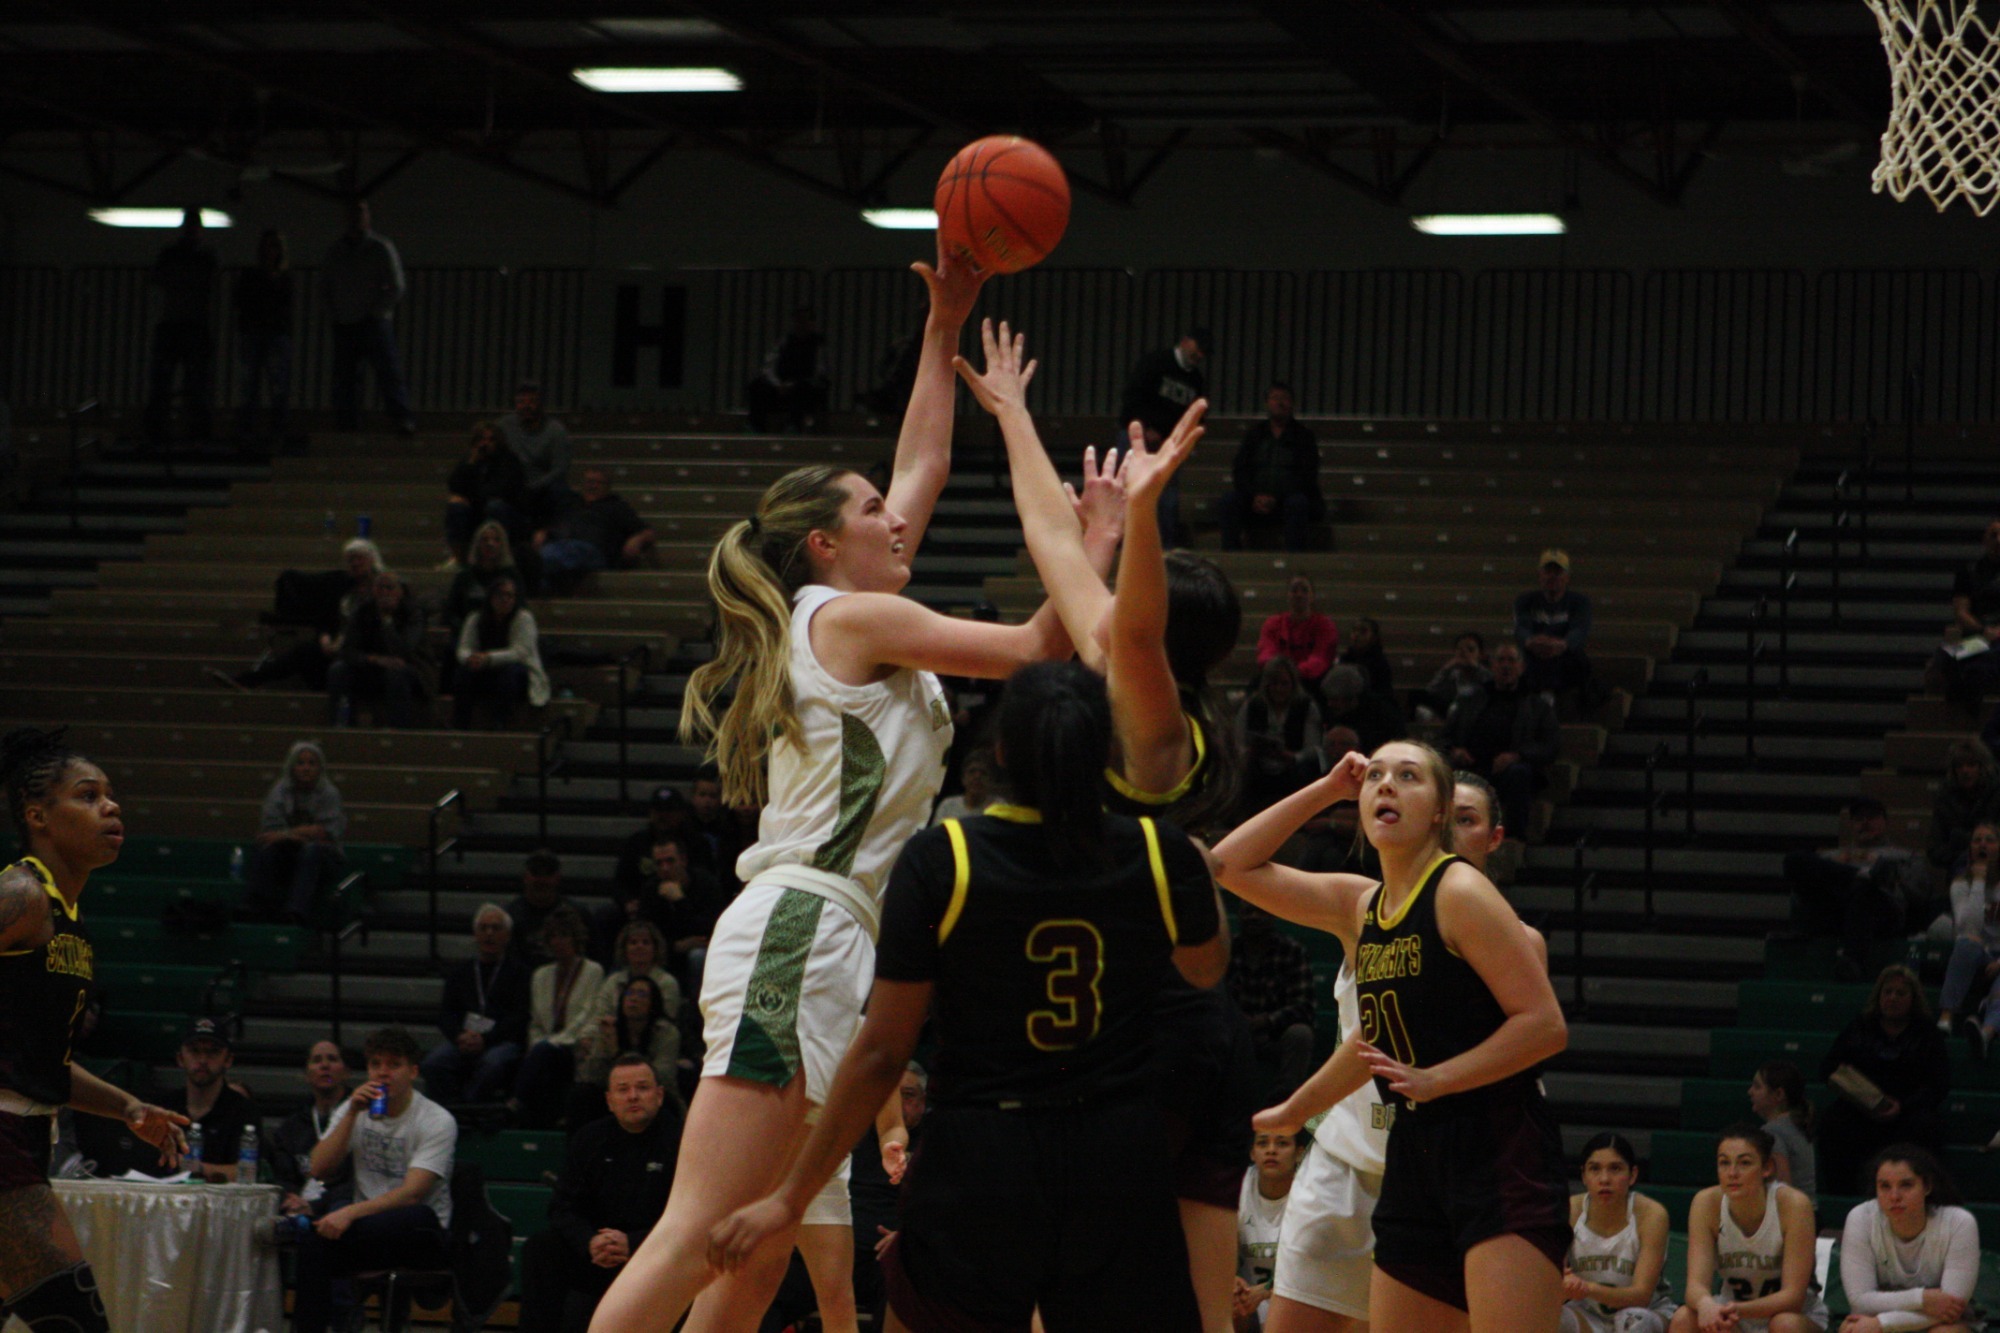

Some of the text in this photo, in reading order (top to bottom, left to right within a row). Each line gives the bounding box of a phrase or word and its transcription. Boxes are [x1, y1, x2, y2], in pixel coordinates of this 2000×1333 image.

[614, 286, 686, 386] H
[1025, 918, 1104, 1052] 3
[1360, 989, 1416, 1067] 21
